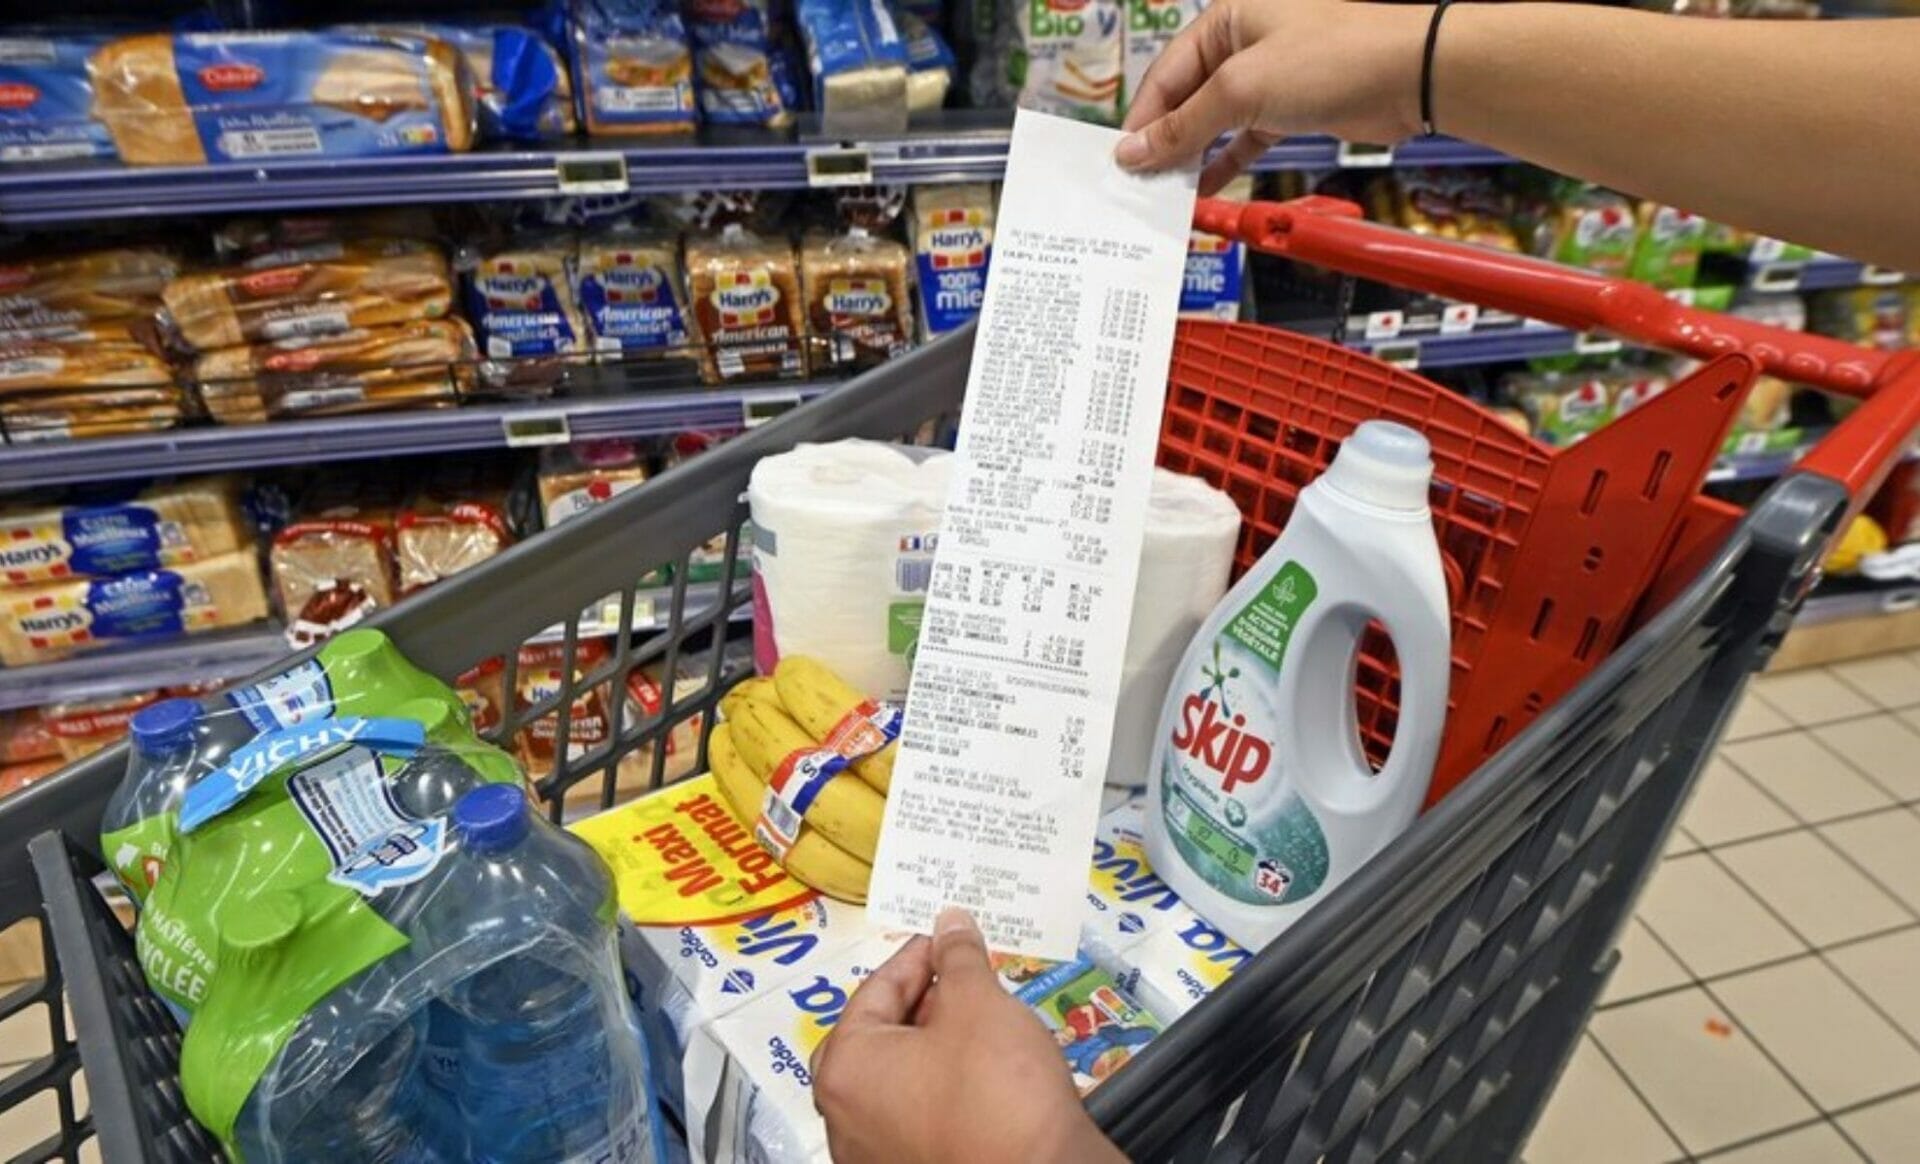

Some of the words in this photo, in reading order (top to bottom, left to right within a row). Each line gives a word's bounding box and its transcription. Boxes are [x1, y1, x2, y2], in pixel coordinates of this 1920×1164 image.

[226, 715, 369, 782] VICHY
[1172, 693, 1271, 795] Skip
[633, 822, 724, 898] Maxi
[674, 793, 788, 896] Format
[1258, 871, 1284, 895] 34
